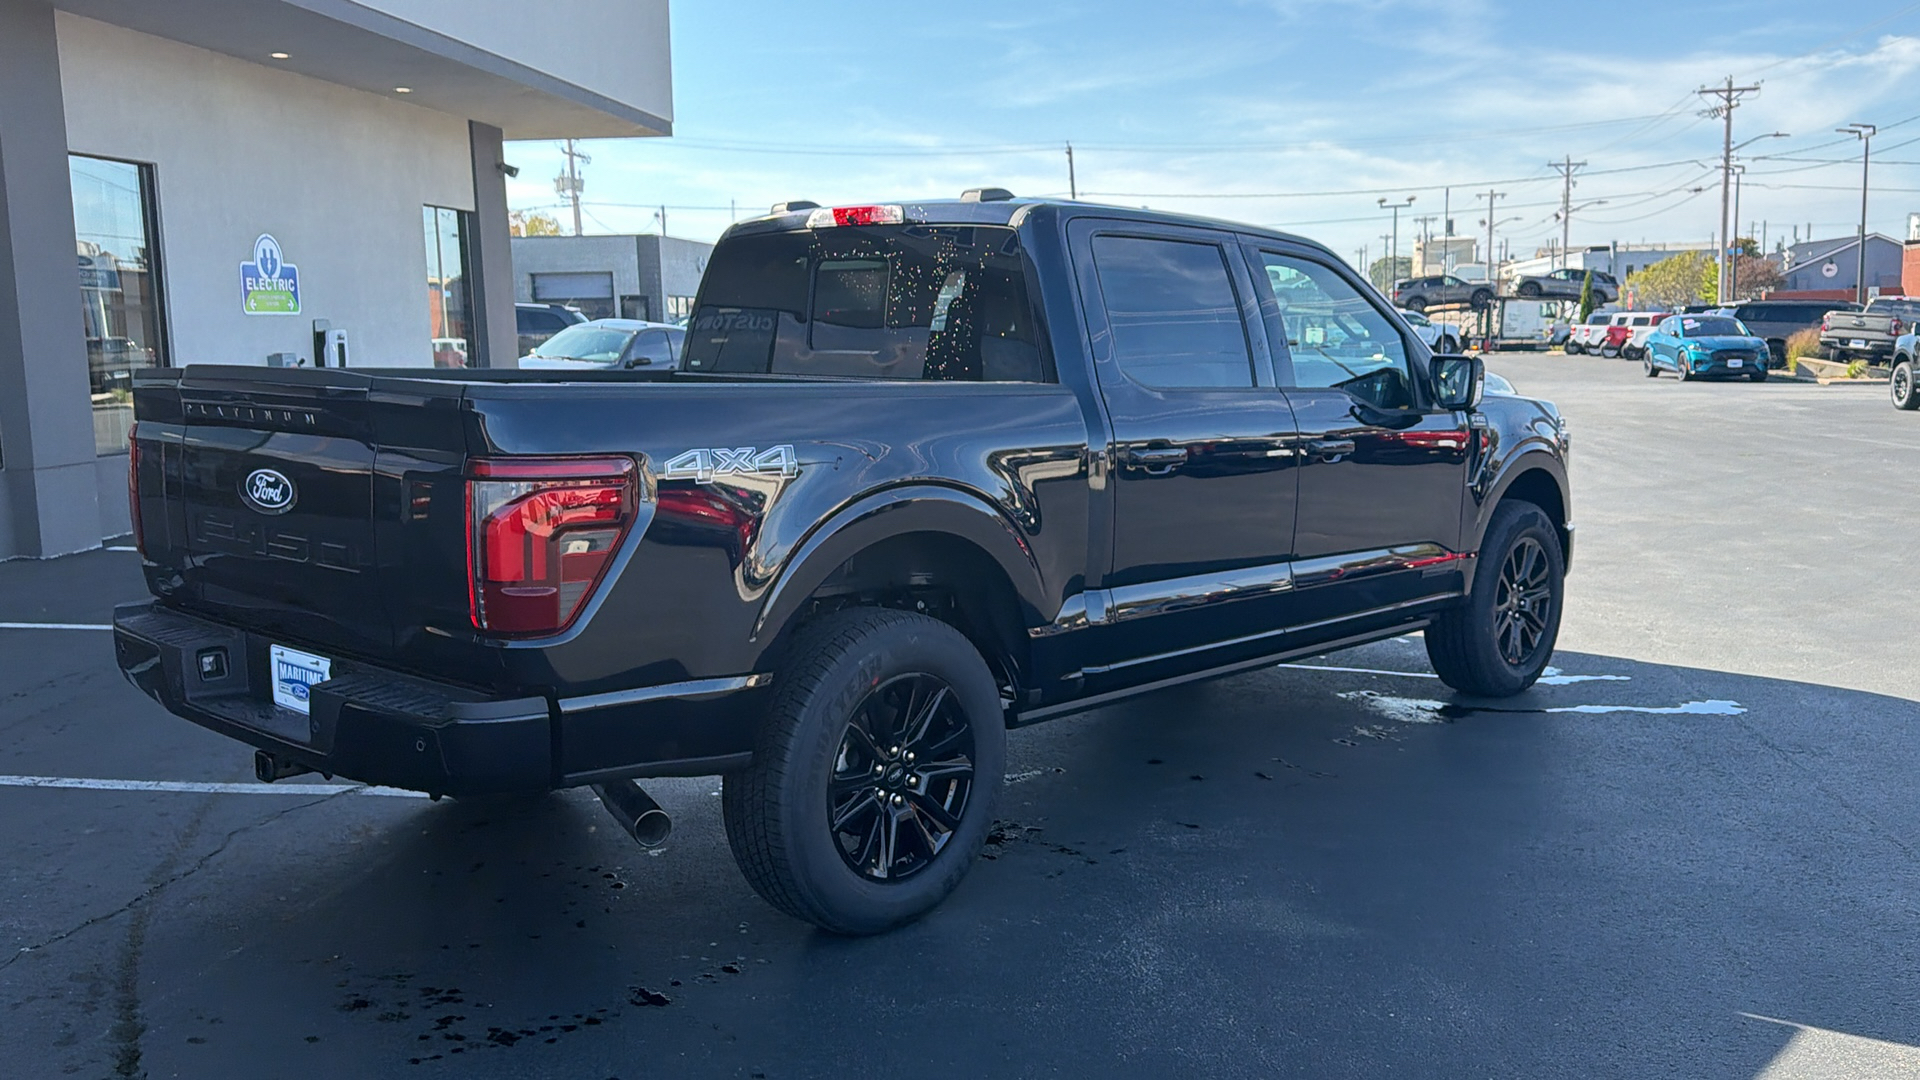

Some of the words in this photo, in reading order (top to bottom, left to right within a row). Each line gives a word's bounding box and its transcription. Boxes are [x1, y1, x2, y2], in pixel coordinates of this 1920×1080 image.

[245, 277, 295, 292] ELECTRIC
[186, 403, 316, 425] PLATINUM
[253, 473, 283, 502] Ford
[279, 662, 323, 686] MARITIME
[293, 685, 308, 700] Ford
